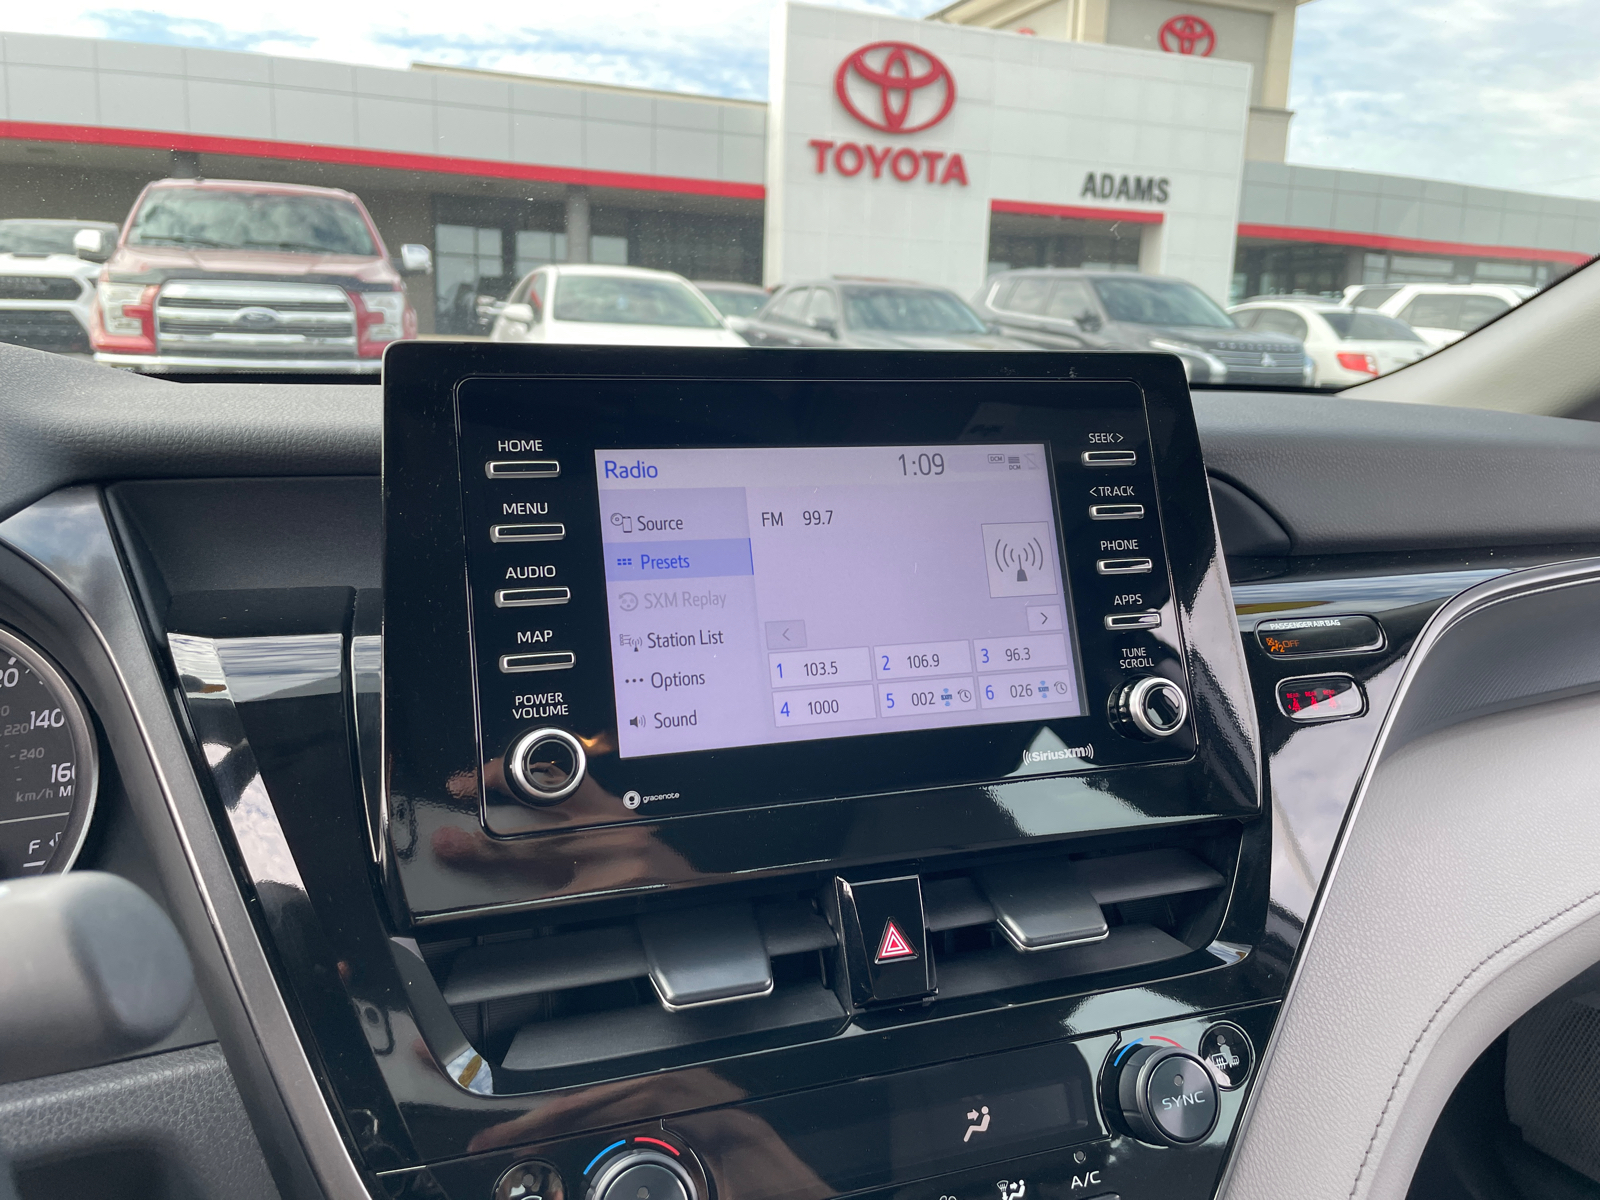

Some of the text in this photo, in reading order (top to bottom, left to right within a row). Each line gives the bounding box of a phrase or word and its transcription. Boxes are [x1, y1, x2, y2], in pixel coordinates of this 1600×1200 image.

[809, 139, 968, 186] TOYOTA
[1081, 171, 1170, 204] ADAMS
[497, 440, 543, 452] HOME
[604, 460, 659, 479] Radio
[898, 453, 945, 476] 1:09
[502, 502, 549, 515] MENU
[637, 516, 684, 532] Source
[761, 510, 834, 527] FM 99.7
[1100, 540, 1139, 551] PHONE
[640, 554, 690, 571] Presets
[505, 565, 556, 580] AUDIO
[644, 590, 727, 610] SXM Replay
[1114, 594, 1143, 606] APPS
[1269, 620, 1313, 630] PASSENGER
[517, 630, 553, 644] MAP
[647, 629, 724, 649] Station List
[1282, 640, 1299, 648] OFF
[980, 647, 1031, 663] 3 96.3
[1122, 647, 1147, 658] TUNE
[776, 661, 838, 679] 1 103.5
[881, 653, 940, 671] 2 106.9
[1120, 657, 1155, 669] SCROLL
[651, 671, 706, 691] Options
[515, 692, 563, 706] POWER
[886, 693, 895, 708] 5
[911, 691, 935, 706] 002
[985, 684, 995, 700] 6
[1010, 684, 1033, 698] 026
[512, 704, 569, 719] VOLUME
[780, 699, 839, 718] 4 1000
[30, 708, 65, 730] 140
[654, 710, 697, 729] Sound
[4, 723, 29, 736] 220
[19, 747, 45, 760] 240
[51, 762, 75, 783] 16
[15, 788, 54, 803] km/h
[642, 792, 680, 804] gracenote
[28, 840, 41, 855] F
[1162, 1090, 1206, 1111] SYNC
[1070, 1170, 1102, 1190] A/C
